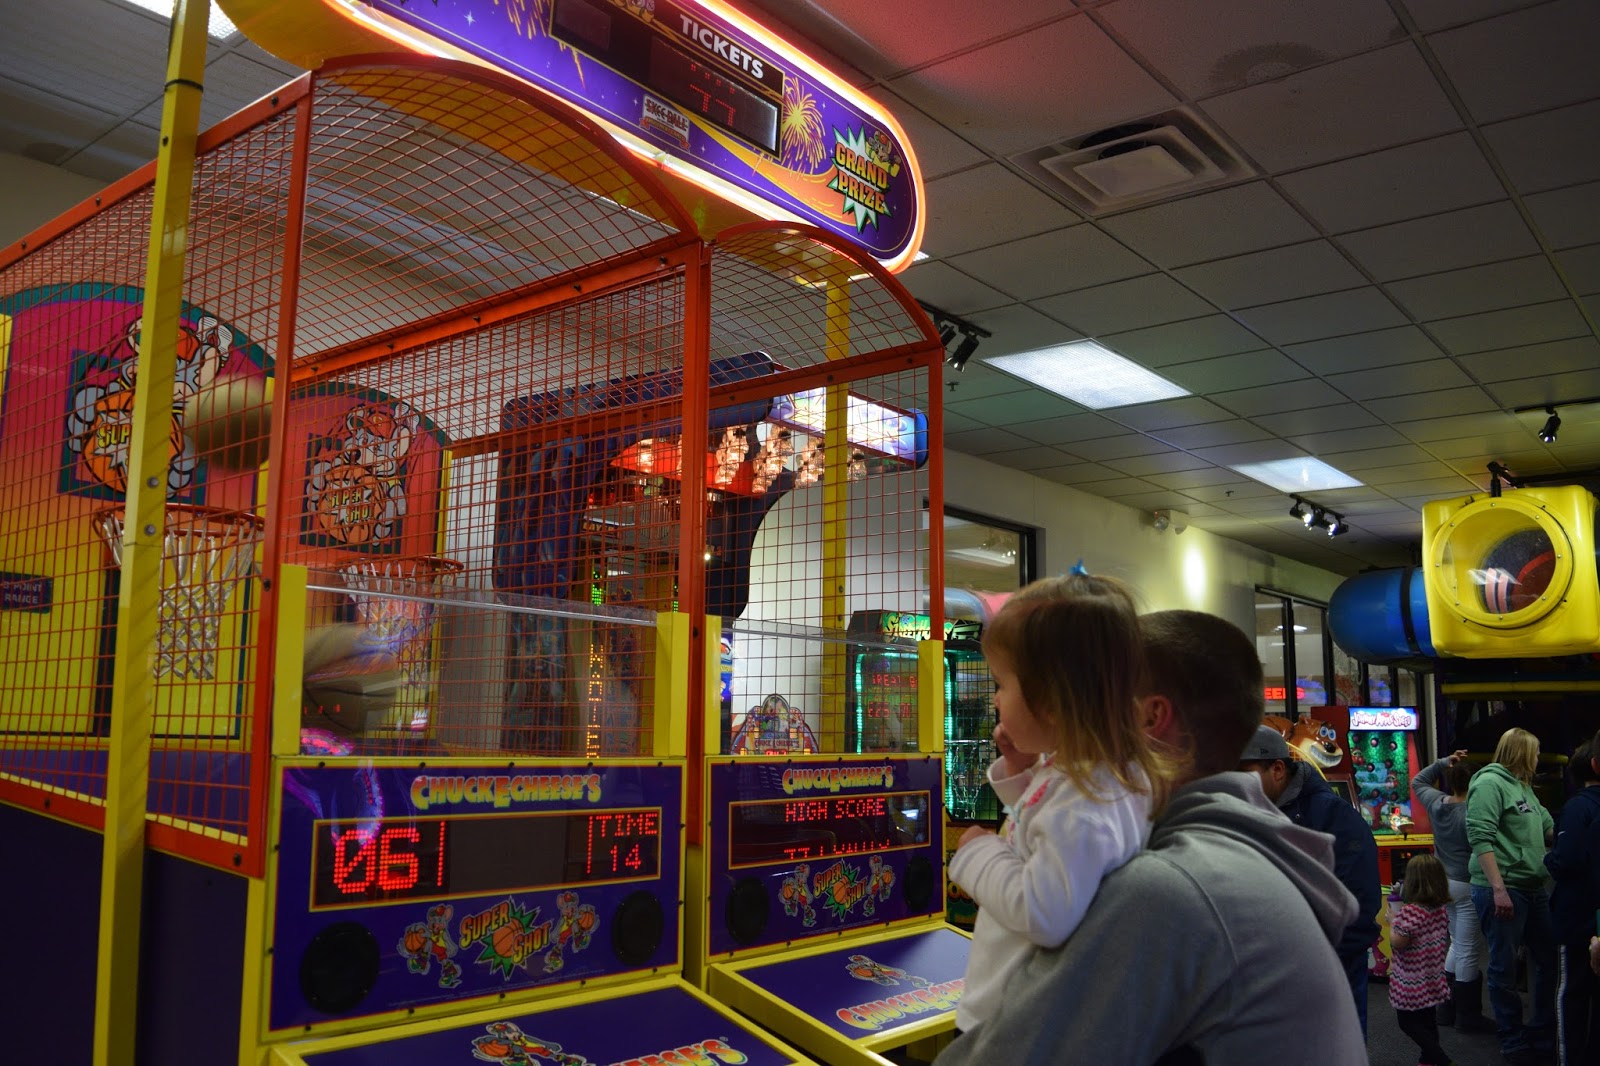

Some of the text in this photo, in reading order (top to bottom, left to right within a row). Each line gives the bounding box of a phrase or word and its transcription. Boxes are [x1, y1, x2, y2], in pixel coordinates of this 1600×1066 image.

[680, 14, 764, 79] TICKETS
[835, 141, 889, 191] GRAND
[837, 168, 886, 215] PRIZE
[97, 422, 132, 449] SUP
[595, 813, 658, 838] TIME
[785, 798, 886, 822] HIGH SCORE
[610, 844, 642, 872] 14
[813, 861, 843, 898] SUPER
[844, 876, 868, 910] SHOT
[459, 899, 510, 949] SUPER
[511, 921, 552, 966] SHOT
